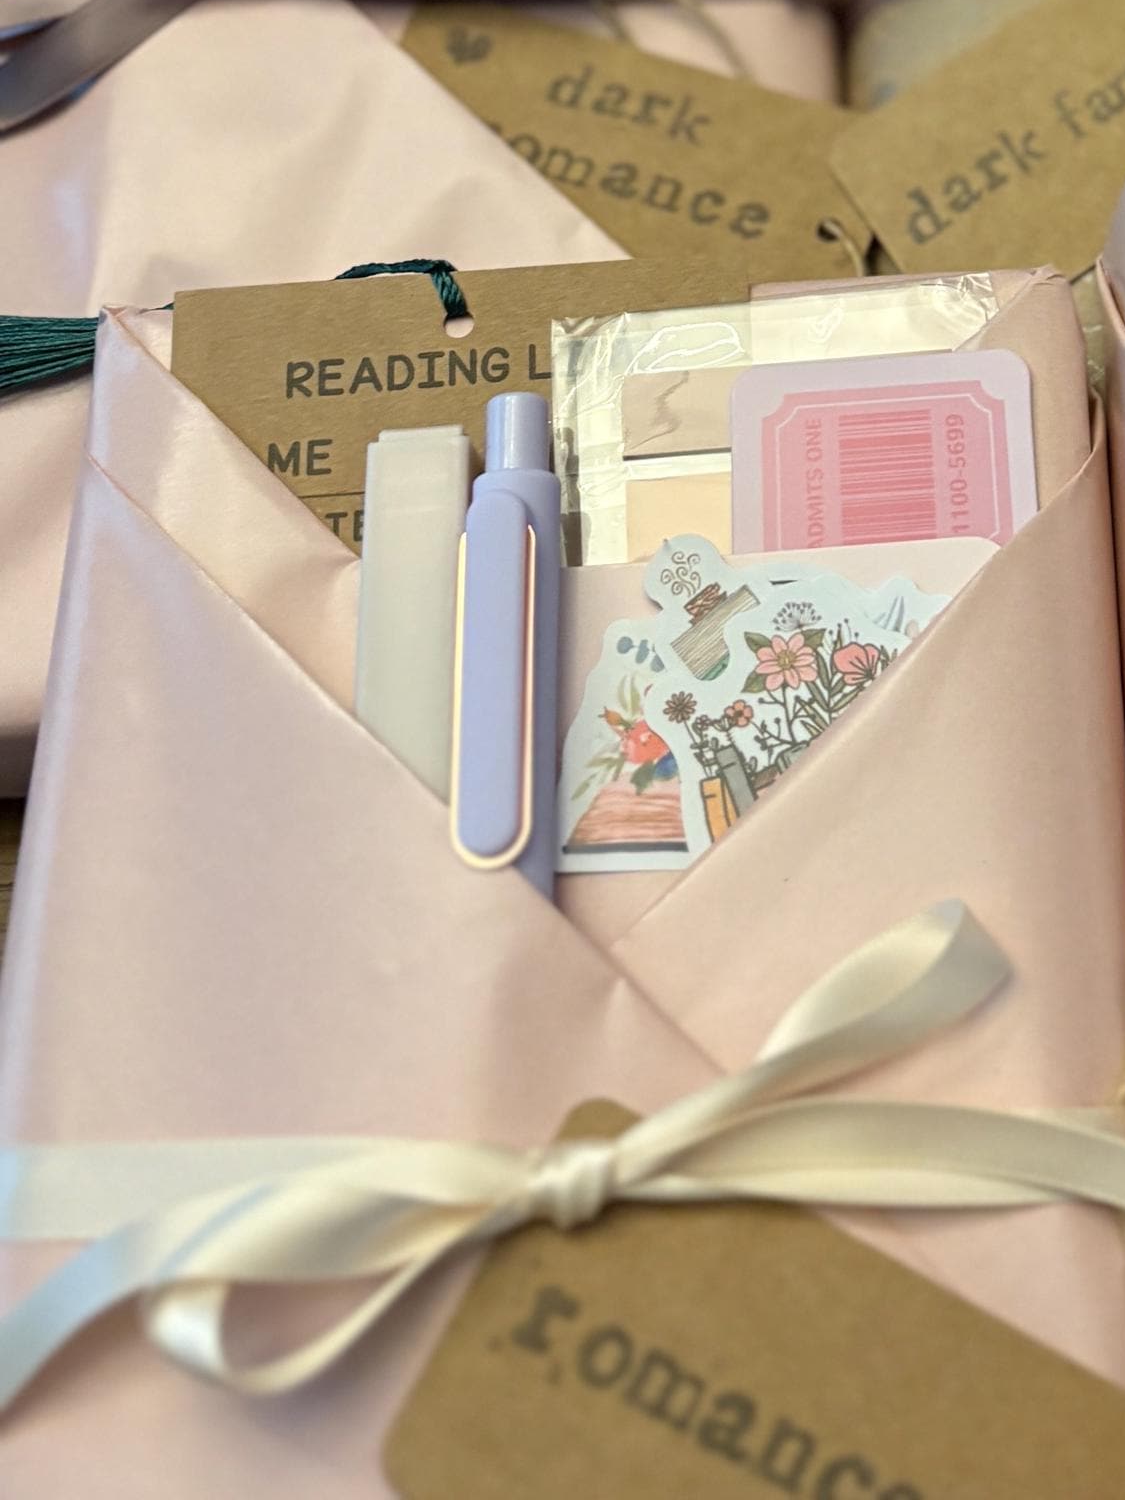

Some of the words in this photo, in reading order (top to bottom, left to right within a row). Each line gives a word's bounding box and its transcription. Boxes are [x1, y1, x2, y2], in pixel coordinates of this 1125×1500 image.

[547, 62, 712, 145] dark
[905, 129, 1045, 247] dark
[286, 346, 510, 399] READING
[267, 438, 333, 477] ME
[805, 418, 823, 463] ONE
[945, 413, 970, 534] 1100-5699
